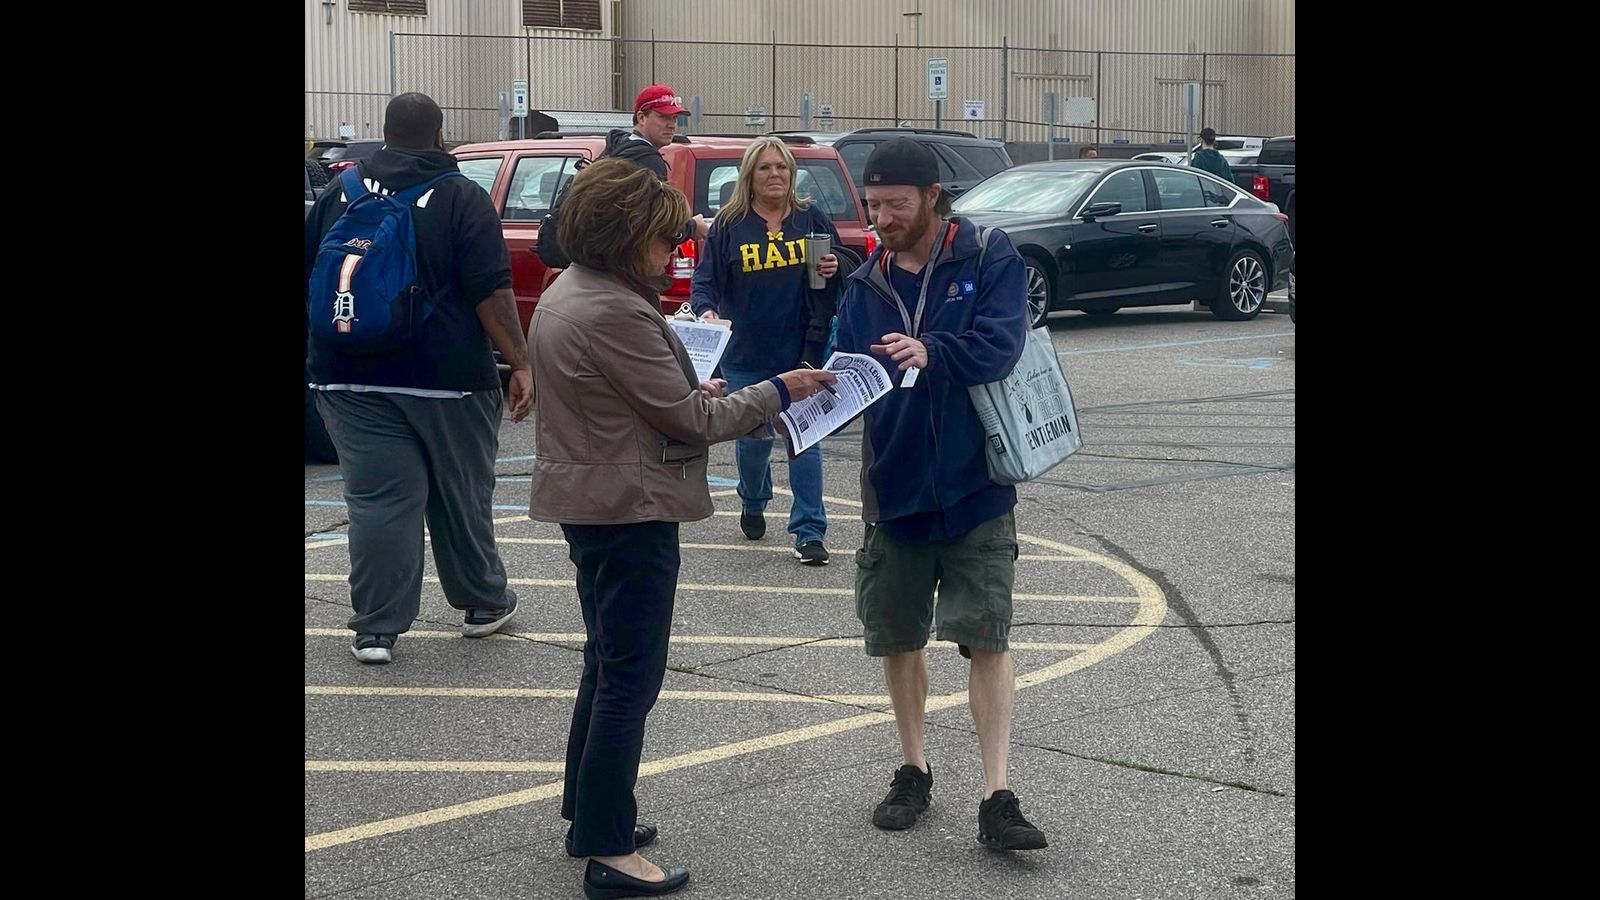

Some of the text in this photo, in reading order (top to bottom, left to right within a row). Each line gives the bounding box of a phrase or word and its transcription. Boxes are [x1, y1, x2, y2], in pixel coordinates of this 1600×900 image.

[332, 290, 356, 323] D
[853, 357, 869, 369] WILL
[868, 365, 886, 392] LEHMAN
